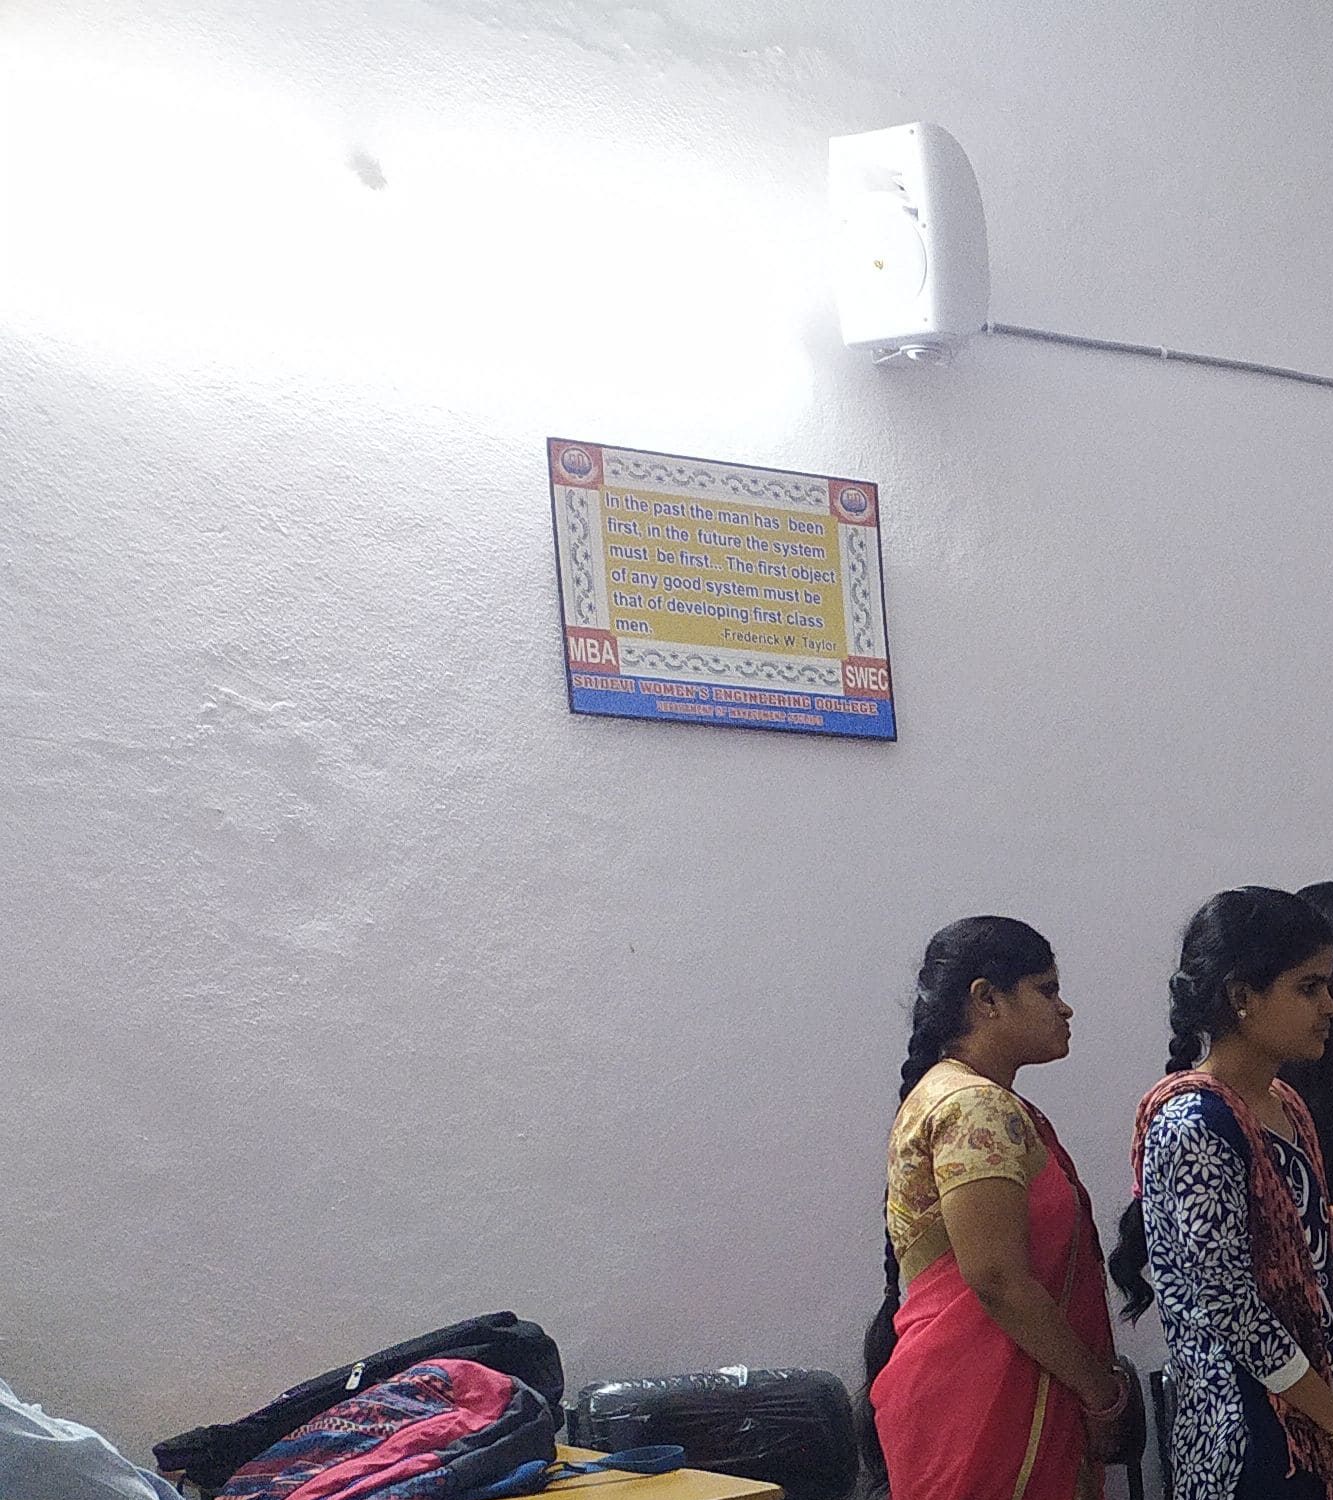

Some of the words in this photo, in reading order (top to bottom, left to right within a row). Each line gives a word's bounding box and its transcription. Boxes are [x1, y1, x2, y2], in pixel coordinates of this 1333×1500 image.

[606, 492, 620, 508] In
[625, 495, 649, 512] the
[654, 502, 686, 518] past
[690, 505, 714, 521] the
[718, 511, 749, 526] man
[754, 513, 780, 529] has
[788, 518, 824, 536] been
[647, 524, 661, 538] in
[666, 526, 689, 542] the
[698, 529, 742, 548] future
[746, 536, 769, 552] the
[773, 542, 825, 559] system
[610, 545, 649, 561] must
[657, 548, 675, 564] be
[727, 556, 754, 574] The
[758, 561, 788, 578] first
[791, 566, 836, 584] object
[612, 568, 628, 582] of
[632, 572, 658, 589] any
[663, 576, 701, 592] good
[706, 581, 759, 597] system
[764, 588, 800, 602] must
[804, 590, 821, 604] be
[614, 592, 643, 608] that
[648, 596, 663, 610] of
[667, 598, 749, 624] developing
[753, 607, 782, 624] first
[787, 612, 824, 628] class
[568, 636, 617, 666] MBA
[802, 636, 837, 653] Taylor
[573, 675, 635, 692] SRIDEVI
[640, 681, 709, 699] WOMEN'S
[714, 688, 810, 709] ENGINEERING
[815, 698, 877, 715] COLLEGE
[846, 665, 889, 692] SWEC
